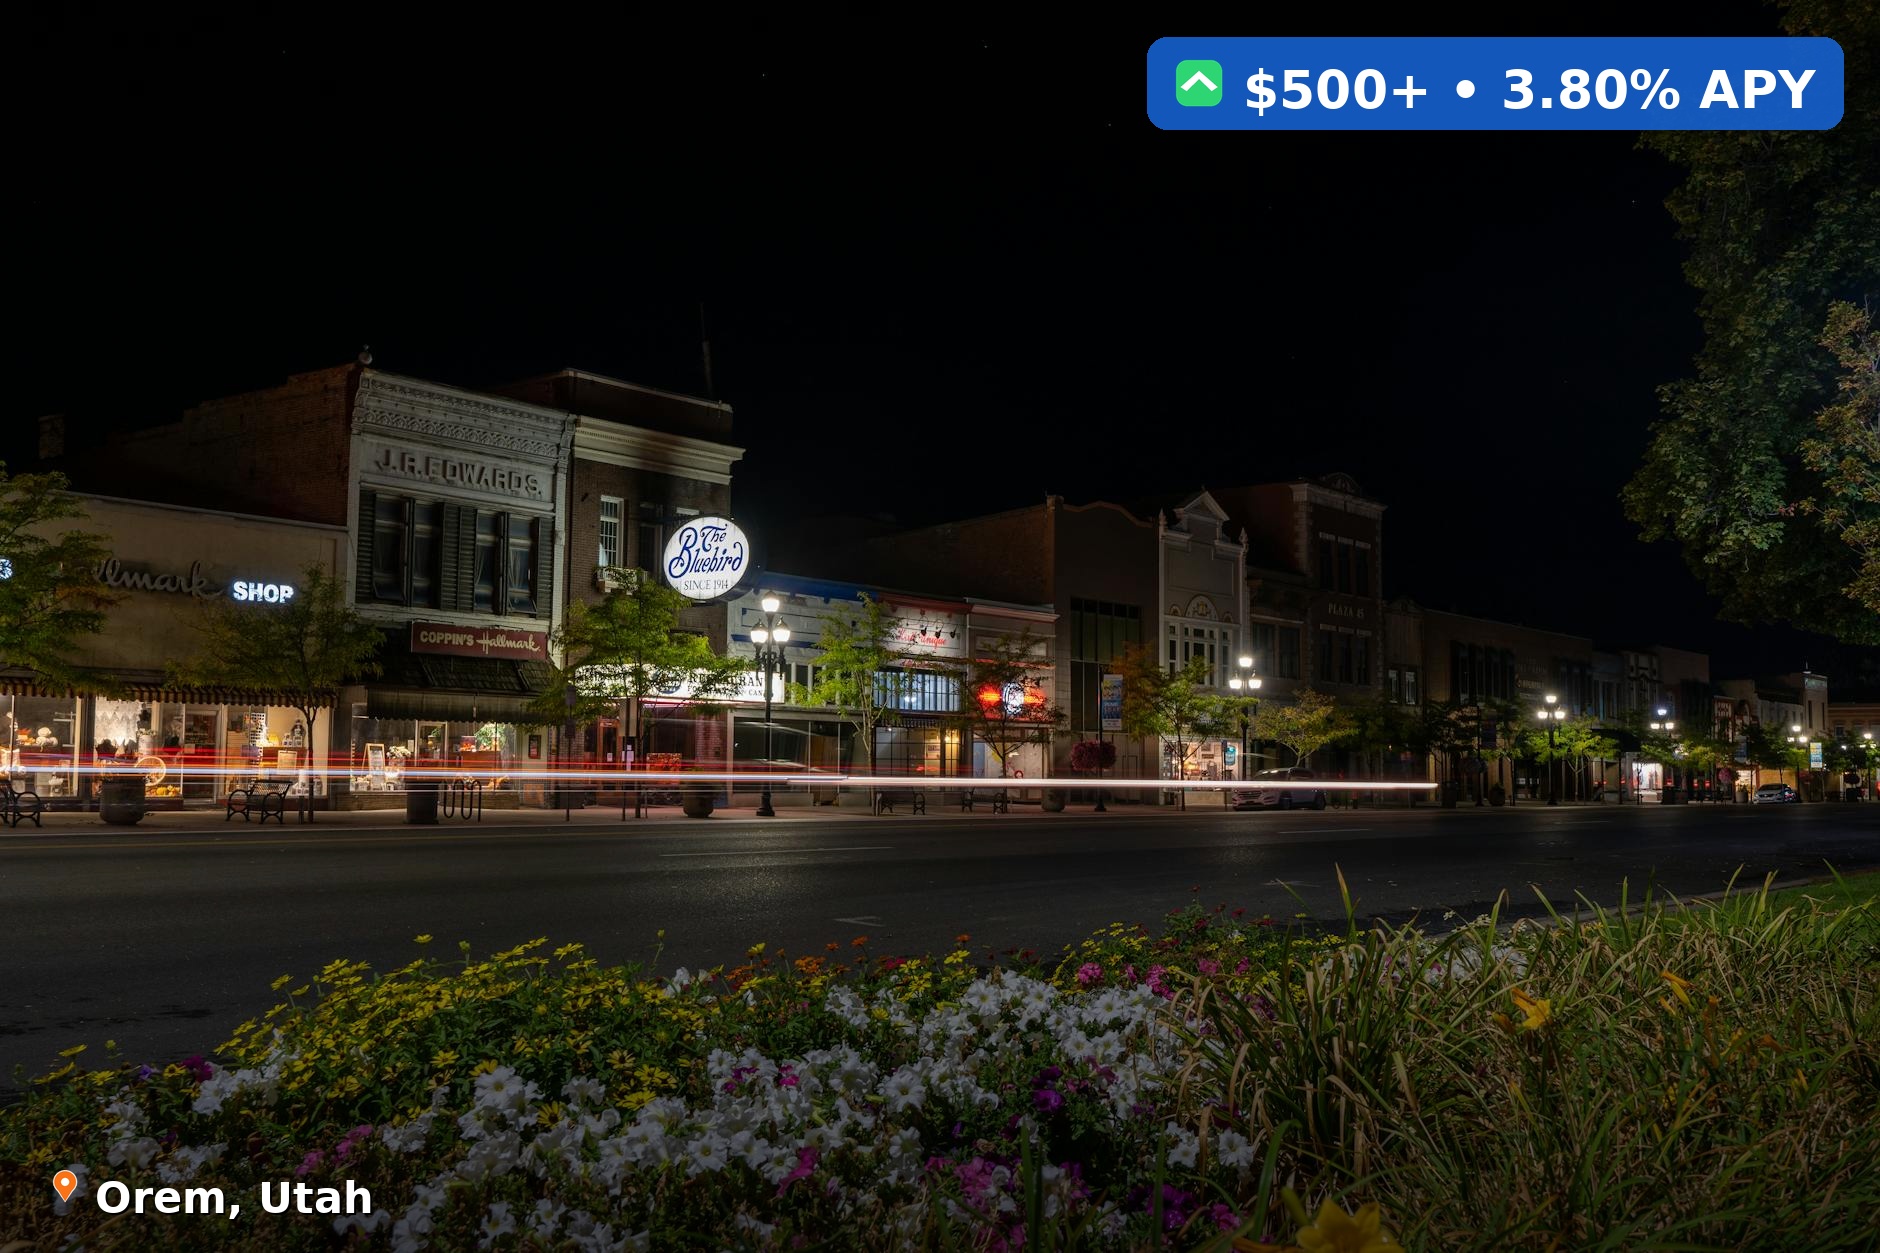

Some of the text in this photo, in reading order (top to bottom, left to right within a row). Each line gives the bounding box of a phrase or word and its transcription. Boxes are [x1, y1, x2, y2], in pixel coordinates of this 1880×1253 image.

[700, 523, 728, 552] The
[668, 526, 744, 579] Bluebird
[232, 580, 295, 604] SHOP
[684, 579, 729, 591] SINCE 1914
[1327, 601, 1354, 617] PLAZA
[419, 629, 541, 655] COPPIN'S Hallmark
